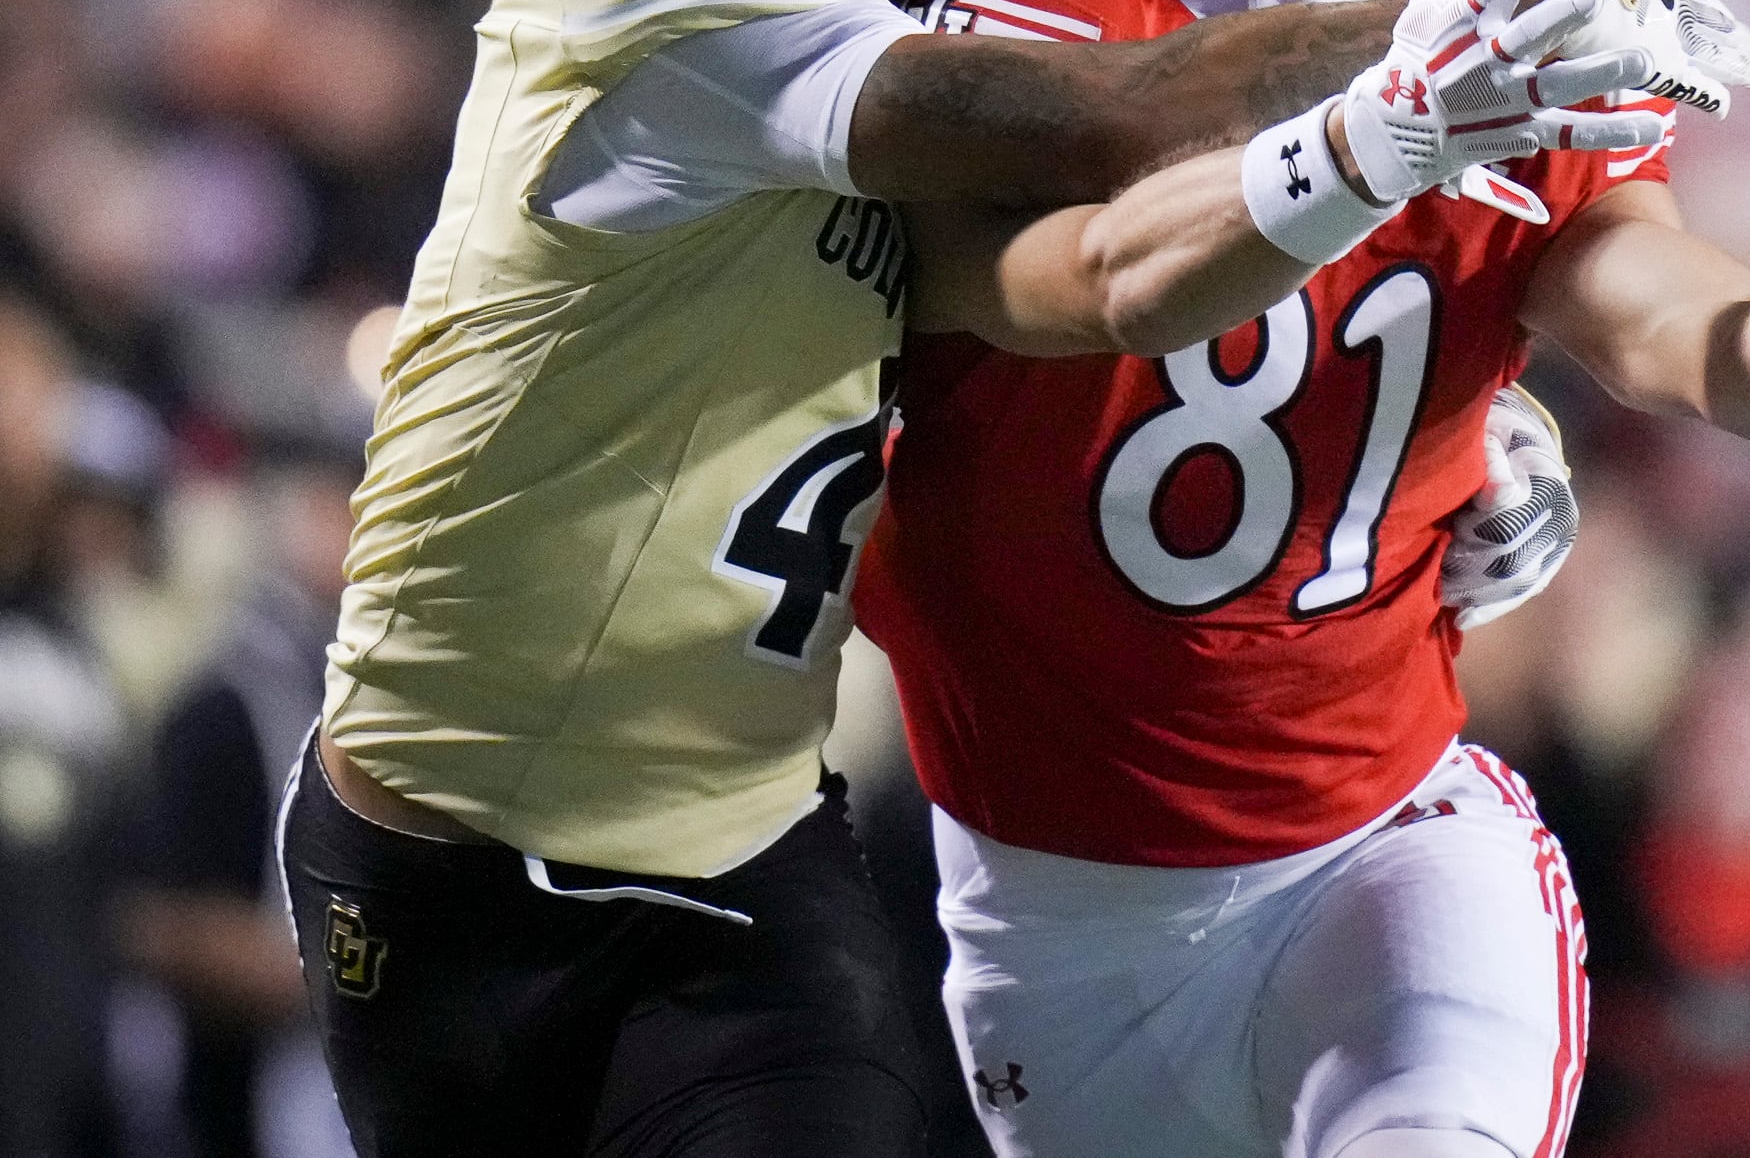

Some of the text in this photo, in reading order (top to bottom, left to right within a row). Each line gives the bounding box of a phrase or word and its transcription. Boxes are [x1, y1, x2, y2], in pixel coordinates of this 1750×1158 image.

[711, 356, 900, 672] 4
[1088, 261, 1443, 620] 81
[325, 893, 389, 999] CU
